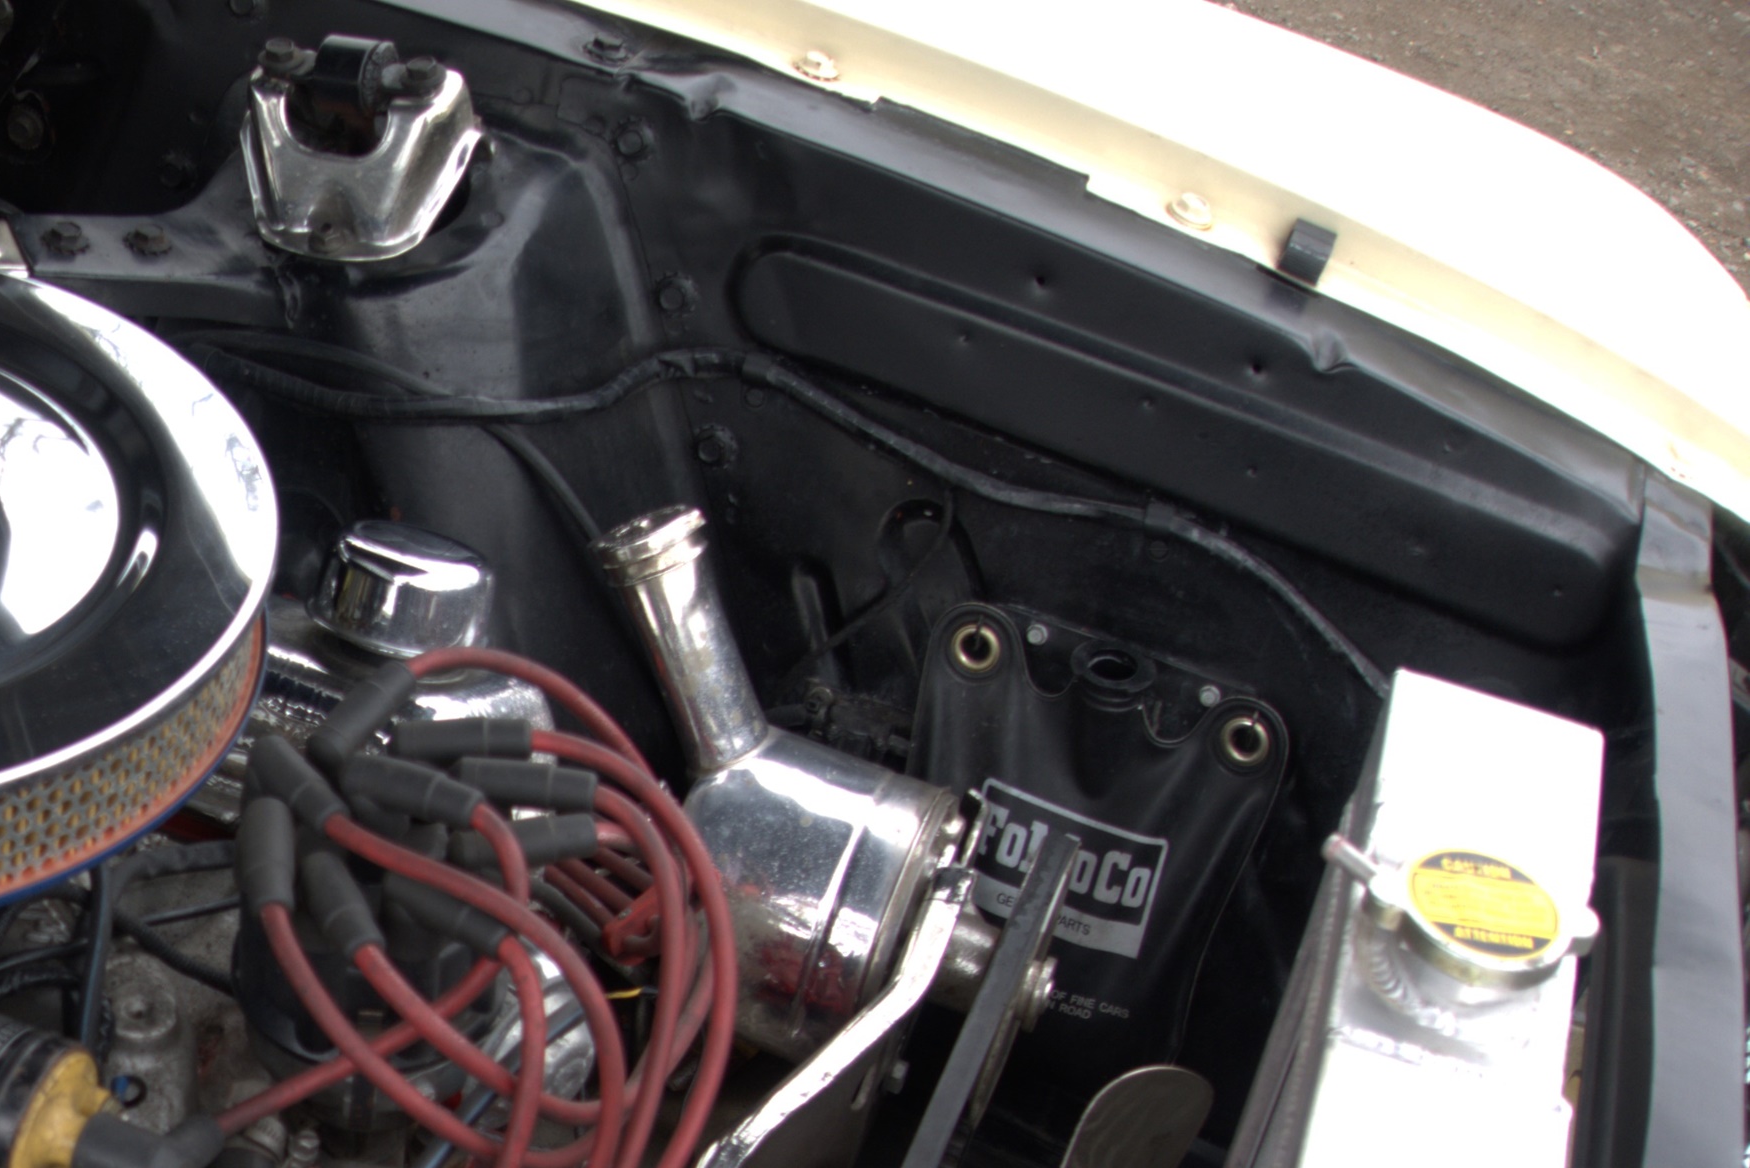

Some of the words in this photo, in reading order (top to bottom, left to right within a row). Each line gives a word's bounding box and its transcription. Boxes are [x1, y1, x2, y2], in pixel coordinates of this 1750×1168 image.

[1056, 914, 1091, 935] ARTS
[1058, 1003, 1092, 1020] ROAD
[1070, 994, 1096, 1009] FINE
[1099, 1002, 1130, 1020] CARS
